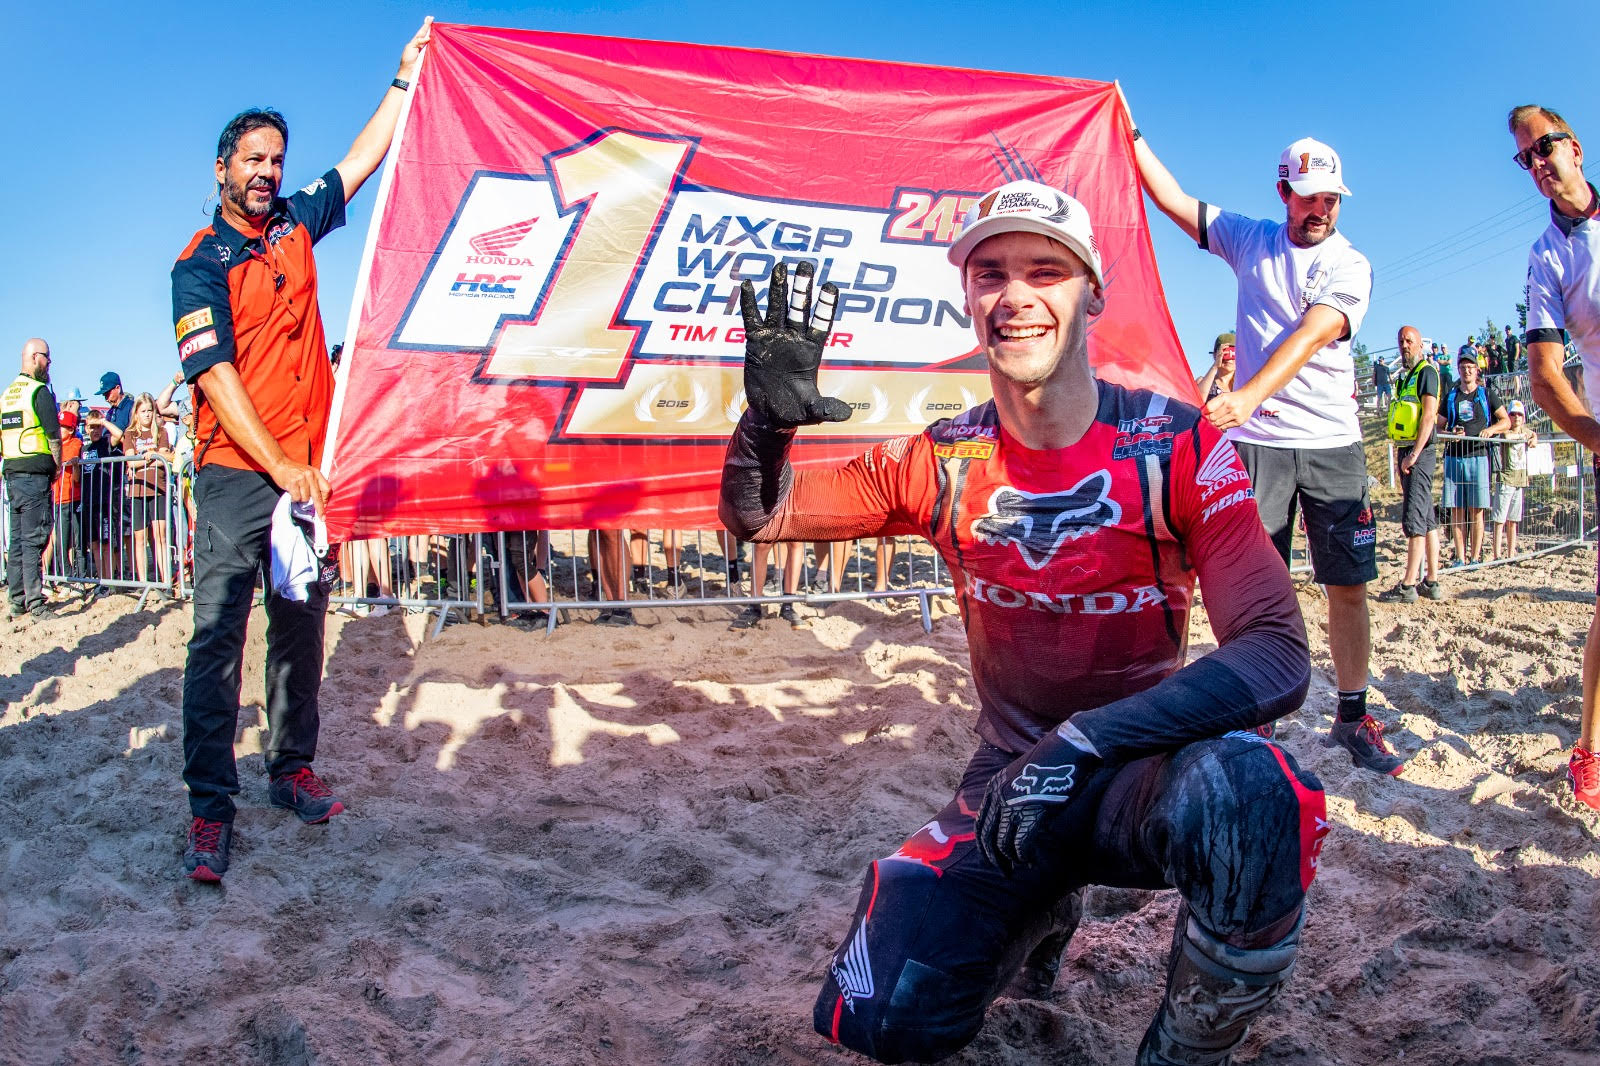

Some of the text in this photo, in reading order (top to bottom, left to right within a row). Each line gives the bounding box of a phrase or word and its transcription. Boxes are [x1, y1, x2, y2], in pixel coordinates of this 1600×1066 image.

[1298, 153, 1309, 174] 1
[978, 190, 1000, 220] 1
[997, 201, 1053, 211] CHAMPION
[1001, 197, 1040, 205] WORLD
[681, 213, 853, 252] MXGP
[465, 255, 535, 267] HONDA
[544, 128, 700, 388] 1
[450, 273, 522, 293] HRC
[653, 281, 973, 329] CHPION
[669, 324, 719, 343] TIM
[656, 399, 689, 408] 2015
[848, 402, 871, 410] 019
[926, 403, 962, 411] 2020
[1259, 410, 1280, 418] HRC
[942, 424, 995, 438] MOTUL
[1114, 432, 1175, 456] HRC
[962, 568, 1169, 615] HONDA
[831, 953, 856, 1015] HONDA
